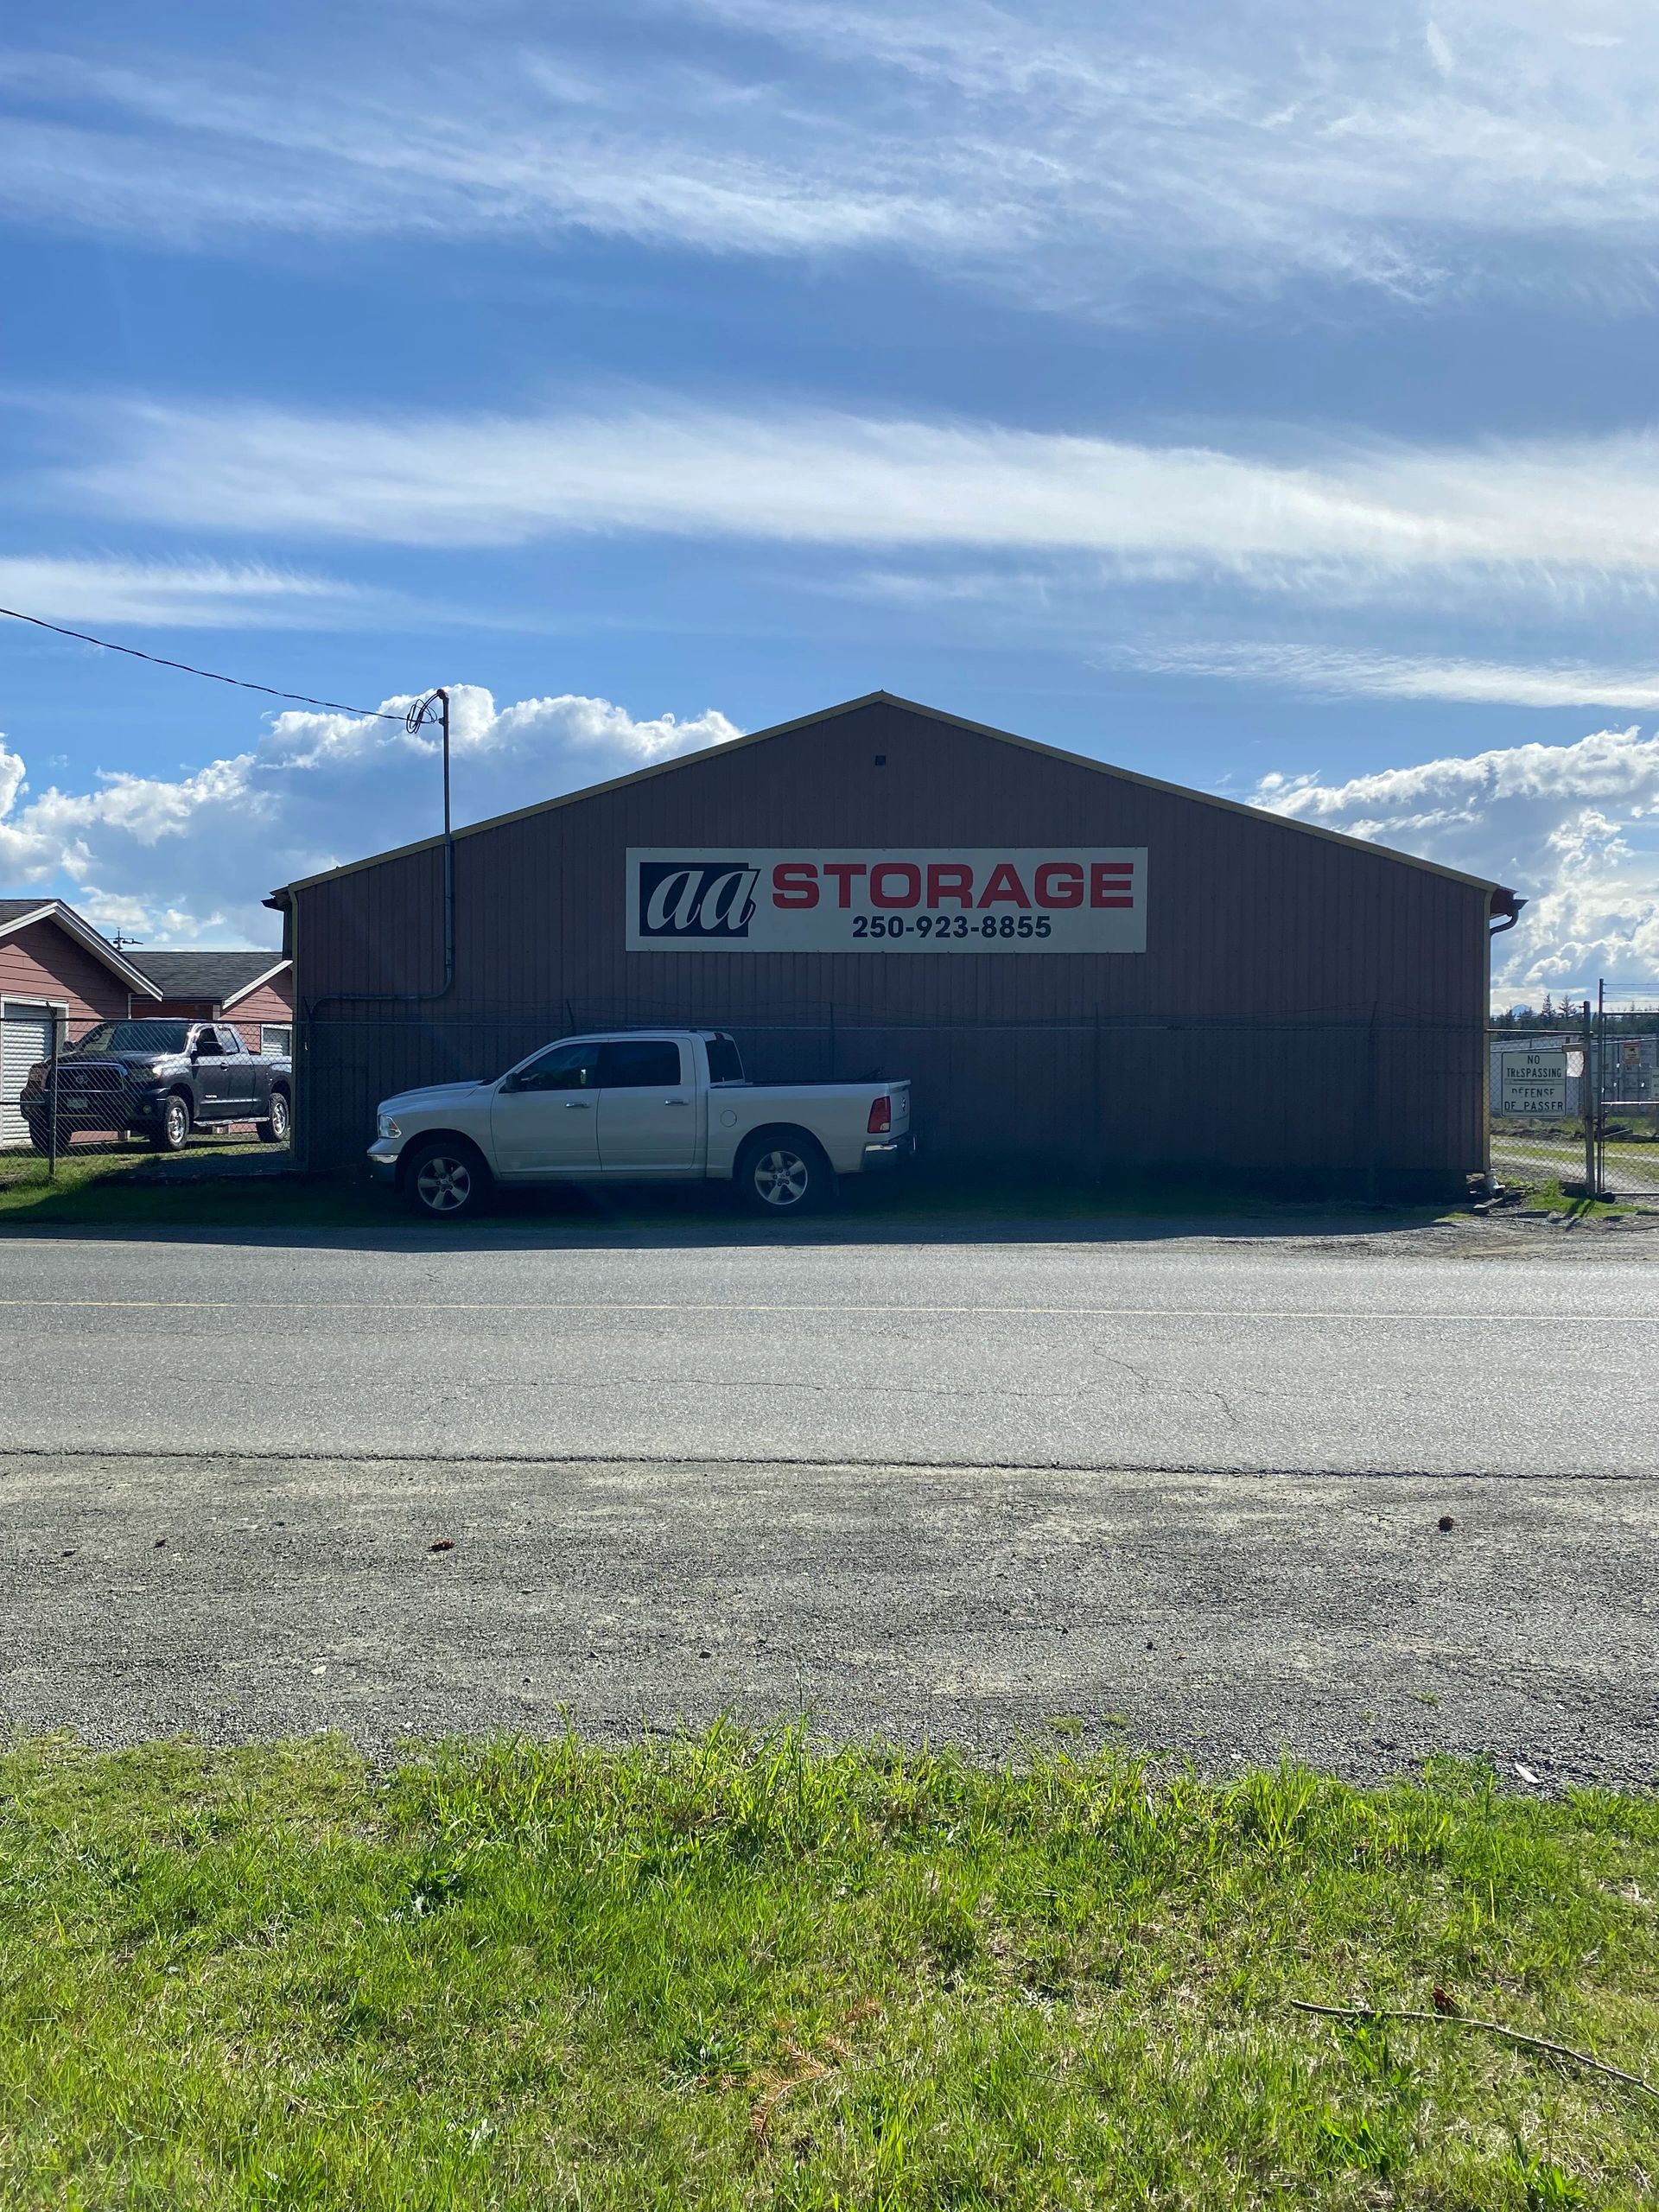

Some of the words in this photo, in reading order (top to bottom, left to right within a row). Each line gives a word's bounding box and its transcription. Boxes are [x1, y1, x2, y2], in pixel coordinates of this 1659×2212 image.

[772, 862, 1135, 909] STORAGE
[852, 916, 1052, 938] 250-923-8855
[1527, 1055, 1541, 1065] NO
[1506, 1068, 1562, 1077] TRESPASSING
